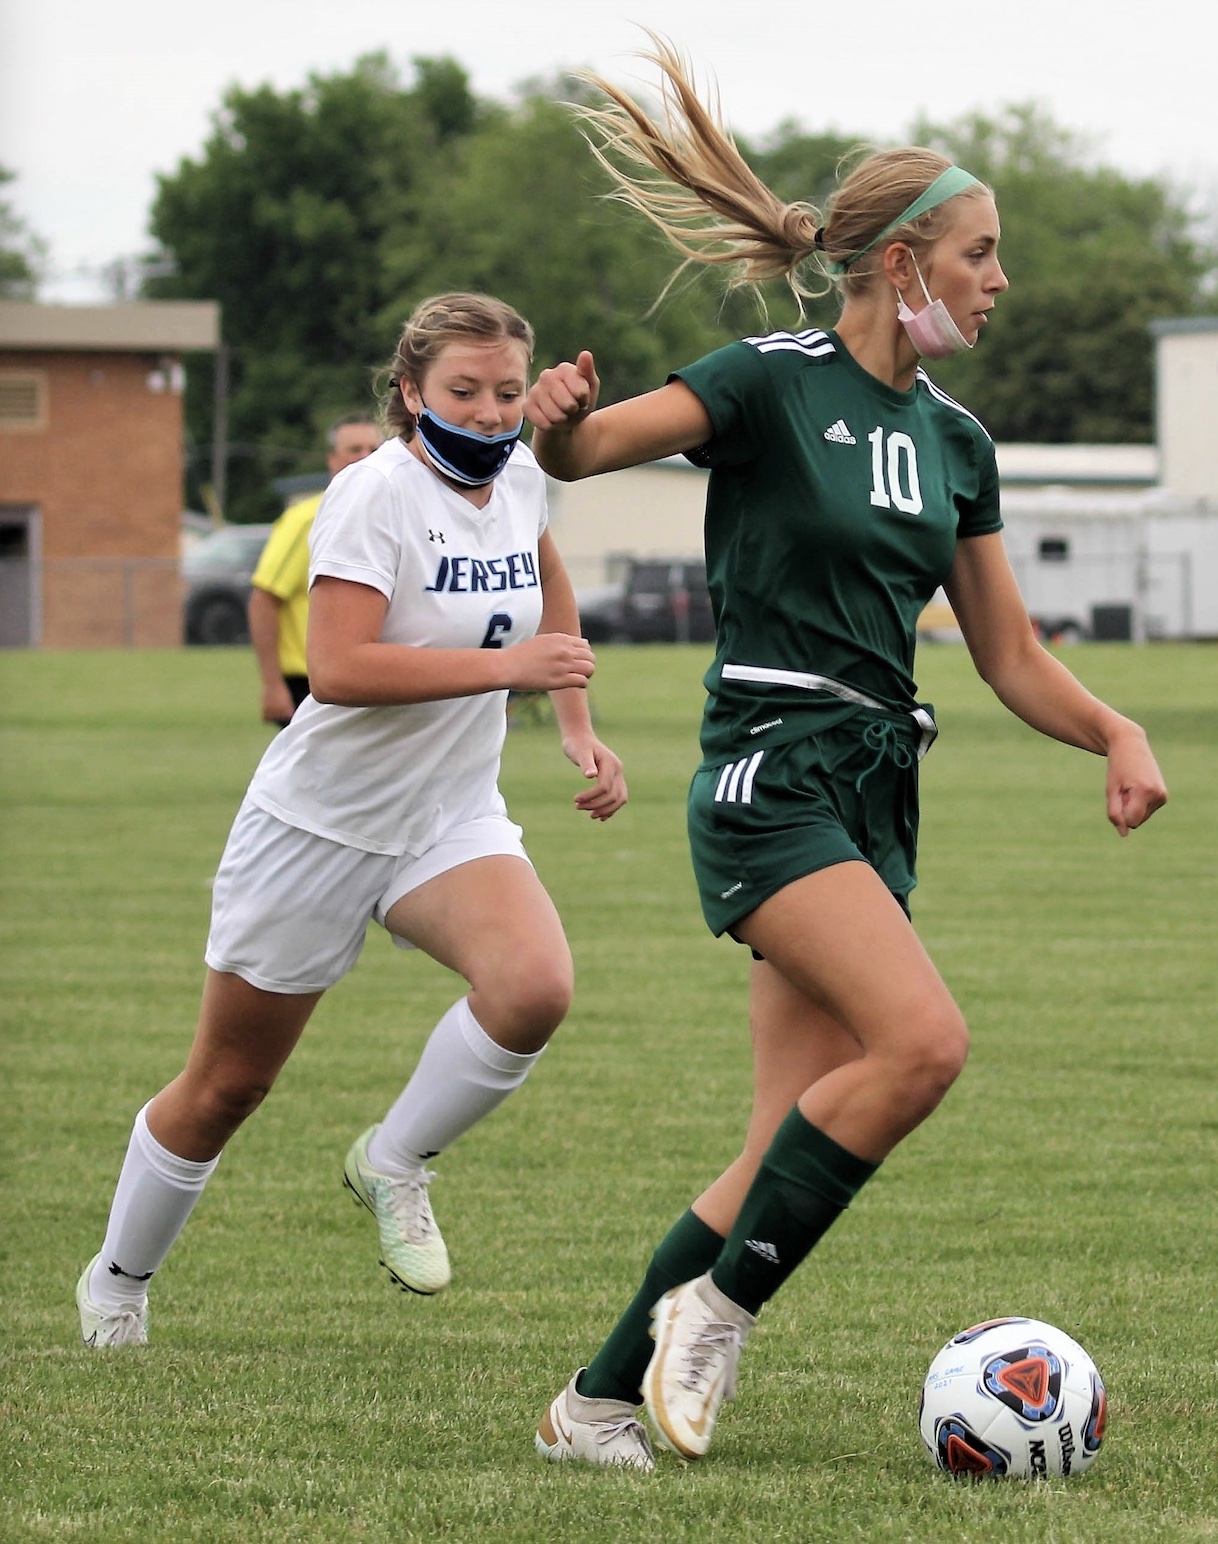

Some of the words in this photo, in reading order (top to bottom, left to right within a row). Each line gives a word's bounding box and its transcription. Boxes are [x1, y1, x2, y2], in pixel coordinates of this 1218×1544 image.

[824, 432, 857, 445] adidas
[868, 425, 924, 516] 10
[423, 551, 538, 593] JERSEY
